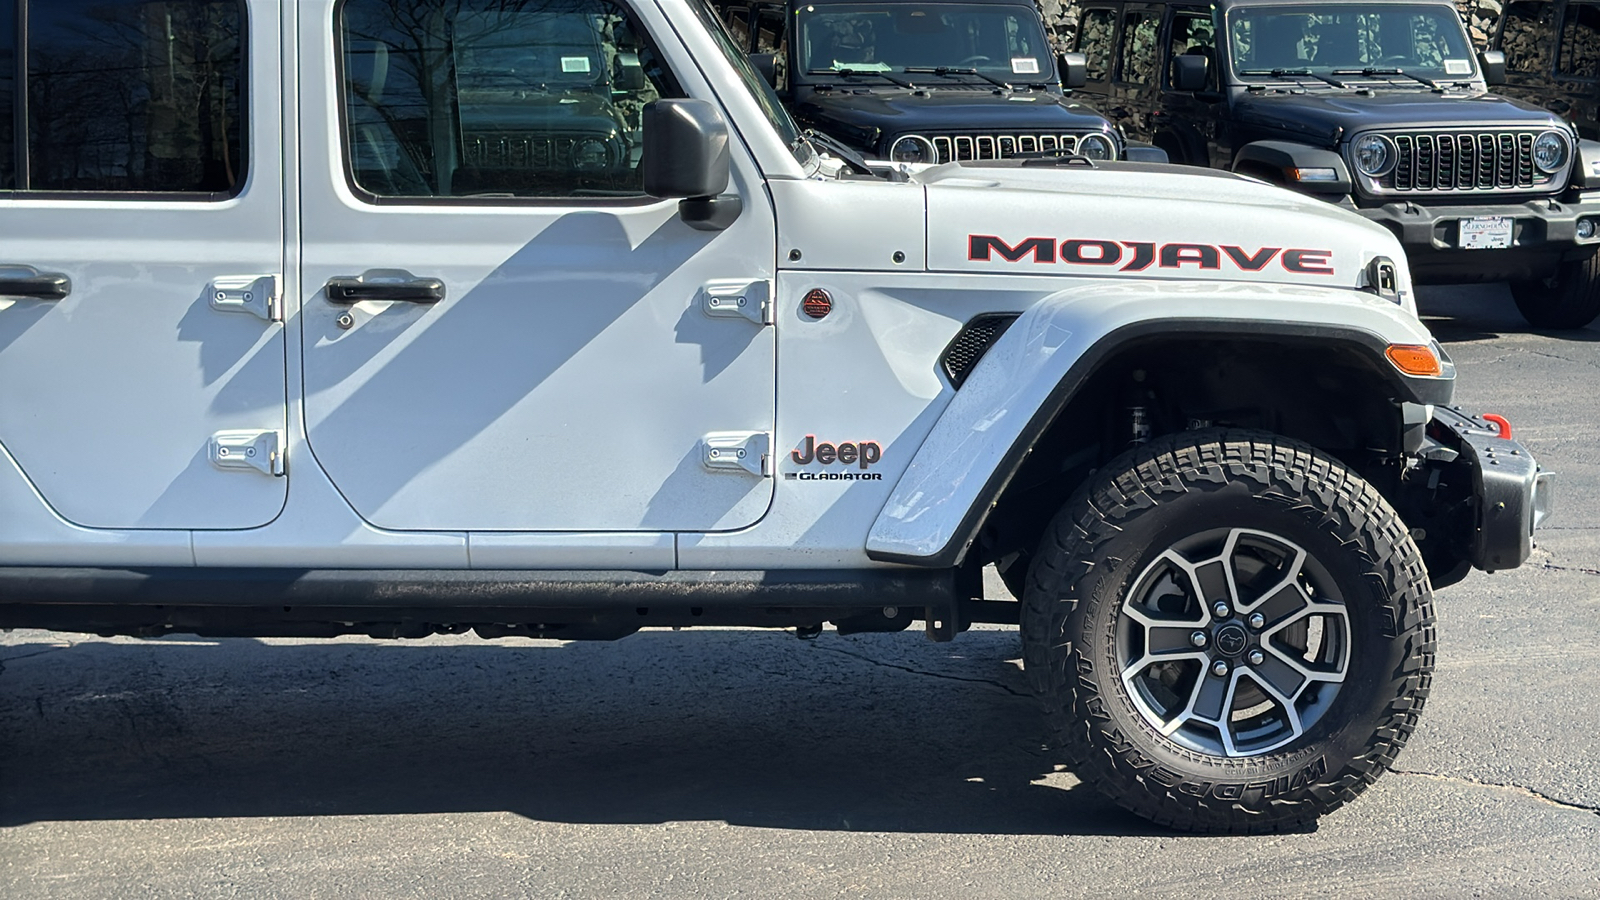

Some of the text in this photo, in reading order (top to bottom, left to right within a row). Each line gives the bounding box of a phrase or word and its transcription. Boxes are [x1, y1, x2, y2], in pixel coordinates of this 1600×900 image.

[968, 234, 1334, 275] MOJAVE
[791, 434, 882, 469] Jeep
[799, 472, 882, 481] GLADIATOR
[1101, 727, 1328, 801] WILDPEAK
